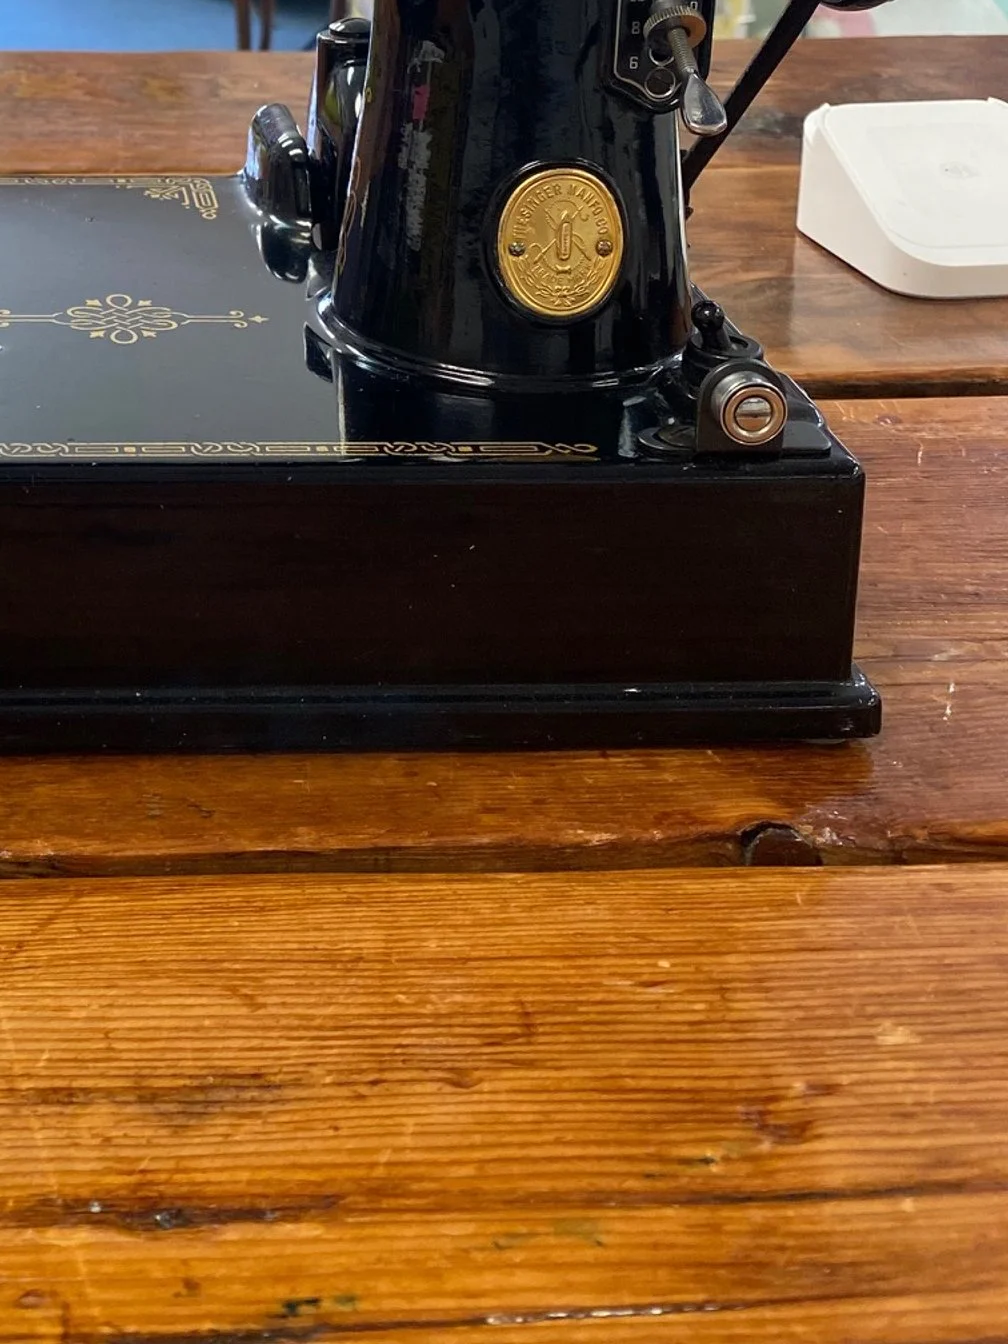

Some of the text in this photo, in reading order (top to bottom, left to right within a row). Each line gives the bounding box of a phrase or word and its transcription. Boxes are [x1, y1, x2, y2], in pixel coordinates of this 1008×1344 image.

[631, 21, 641, 35] 8
[629, 56, 639, 70] 6
[520, 183, 563, 220] SINGER
